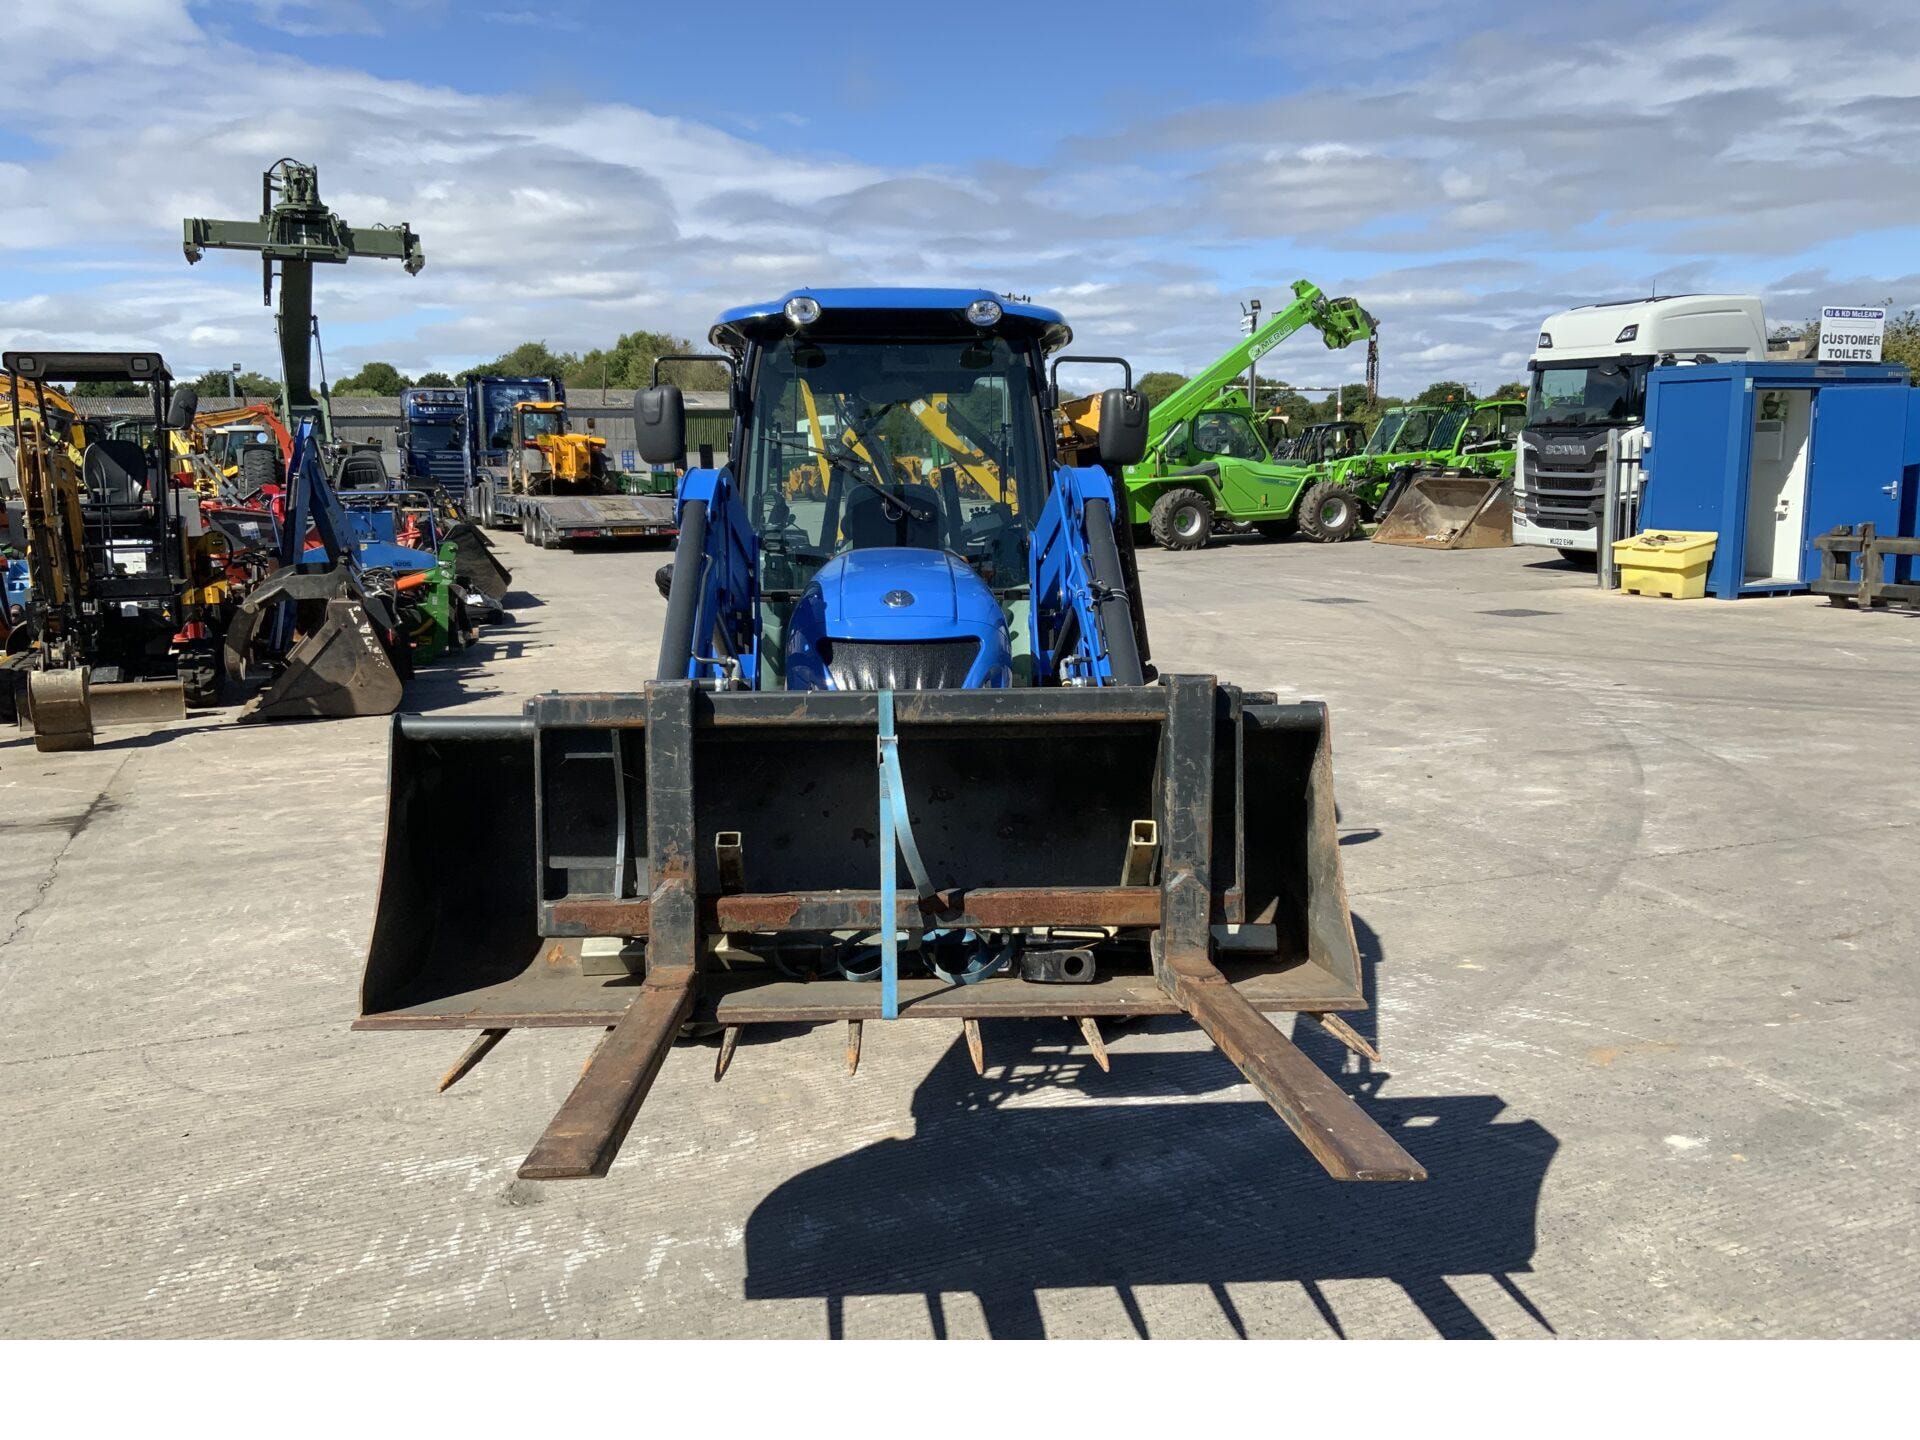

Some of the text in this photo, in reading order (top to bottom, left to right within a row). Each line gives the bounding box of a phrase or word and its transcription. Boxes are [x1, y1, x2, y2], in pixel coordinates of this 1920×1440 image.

[1261, 324, 1291, 349] MERLO
[1822, 334, 1880, 346] CUSTOMER
[1828, 348, 1872, 359] TOILETS
[1545, 444, 1586, 455] SCANIA
